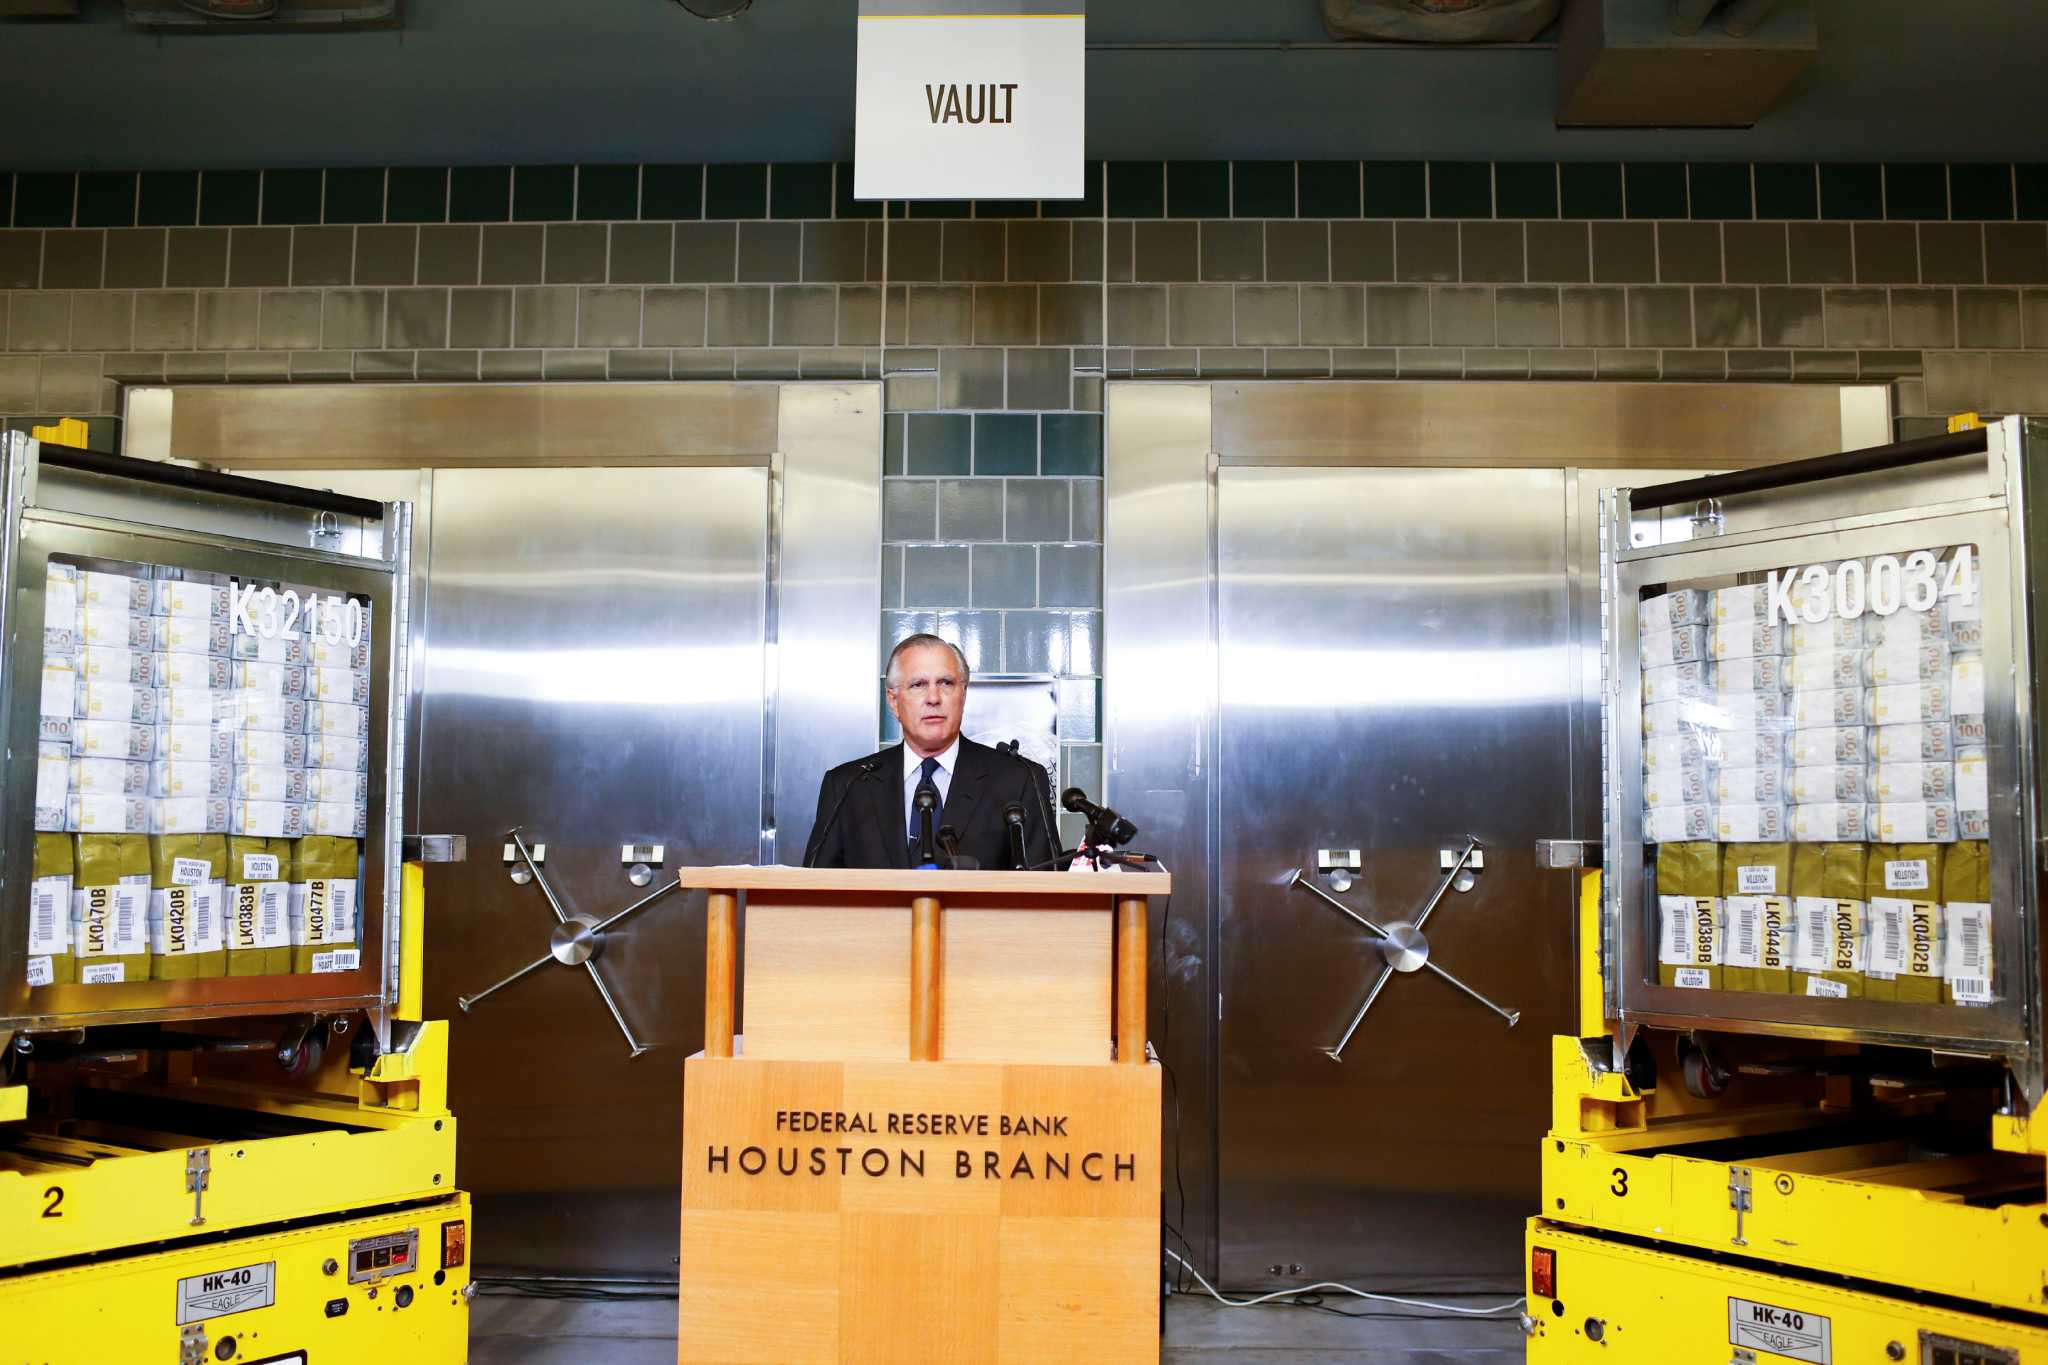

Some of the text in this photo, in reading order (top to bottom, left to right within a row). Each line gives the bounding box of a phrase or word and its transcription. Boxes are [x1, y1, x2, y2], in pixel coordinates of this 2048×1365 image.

[925, 83, 1018, 124] VAULT
[1767, 545, 1978, 627] K30034
[220, 591, 231, 615] 100
[229, 581, 362, 648] K32150
[218, 626, 228, 651] 100
[1680, 631, 1690, 656] 100
[1954, 630, 1980, 642] 100
[139, 656, 150, 681] 100
[217, 662, 227, 684] 100
[290, 670, 301, 694] 100
[141, 692, 151, 717] 100
[42, 722, 69, 734] 100
[1958, 724, 1984, 737] 100
[292, 738, 301, 762] 100
[293, 773, 303, 797] 100
[215, 803, 225, 827] 100
[290, 808, 300, 832] 100
[1935, 808, 1947, 833] 100
[180, 867, 203, 877] HOUSTON
[251, 863, 272, 871] HOUSTON
[89, 888, 107, 952] LK0470B
[170, 889, 185, 952] LK0420B
[240, 885, 255, 945] LK0383B
[310, 881, 324, 940] LK0477B
[1696, 900, 1712, 963] LK0389B
[1765, 902, 1781, 967] LK0444B
[1836, 903, 1852, 969] LK0462B
[1912, 904, 1929, 974] LK0402B
[776, 1111, 1068, 1137] FEDERAL RESERVE BANK
[708, 1145, 1136, 1182] HOUSTON BRANCH
[1610, 1167, 1629, 1198] 3
[42, 1186, 64, 1218] 2
[203, 1269, 251, 1292] HK-40
[211, 1294, 241, 1310] EAGLE
[1753, 1305, 1804, 1331] HK-40
[1763, 1332, 1793, 1348] EAGLE
